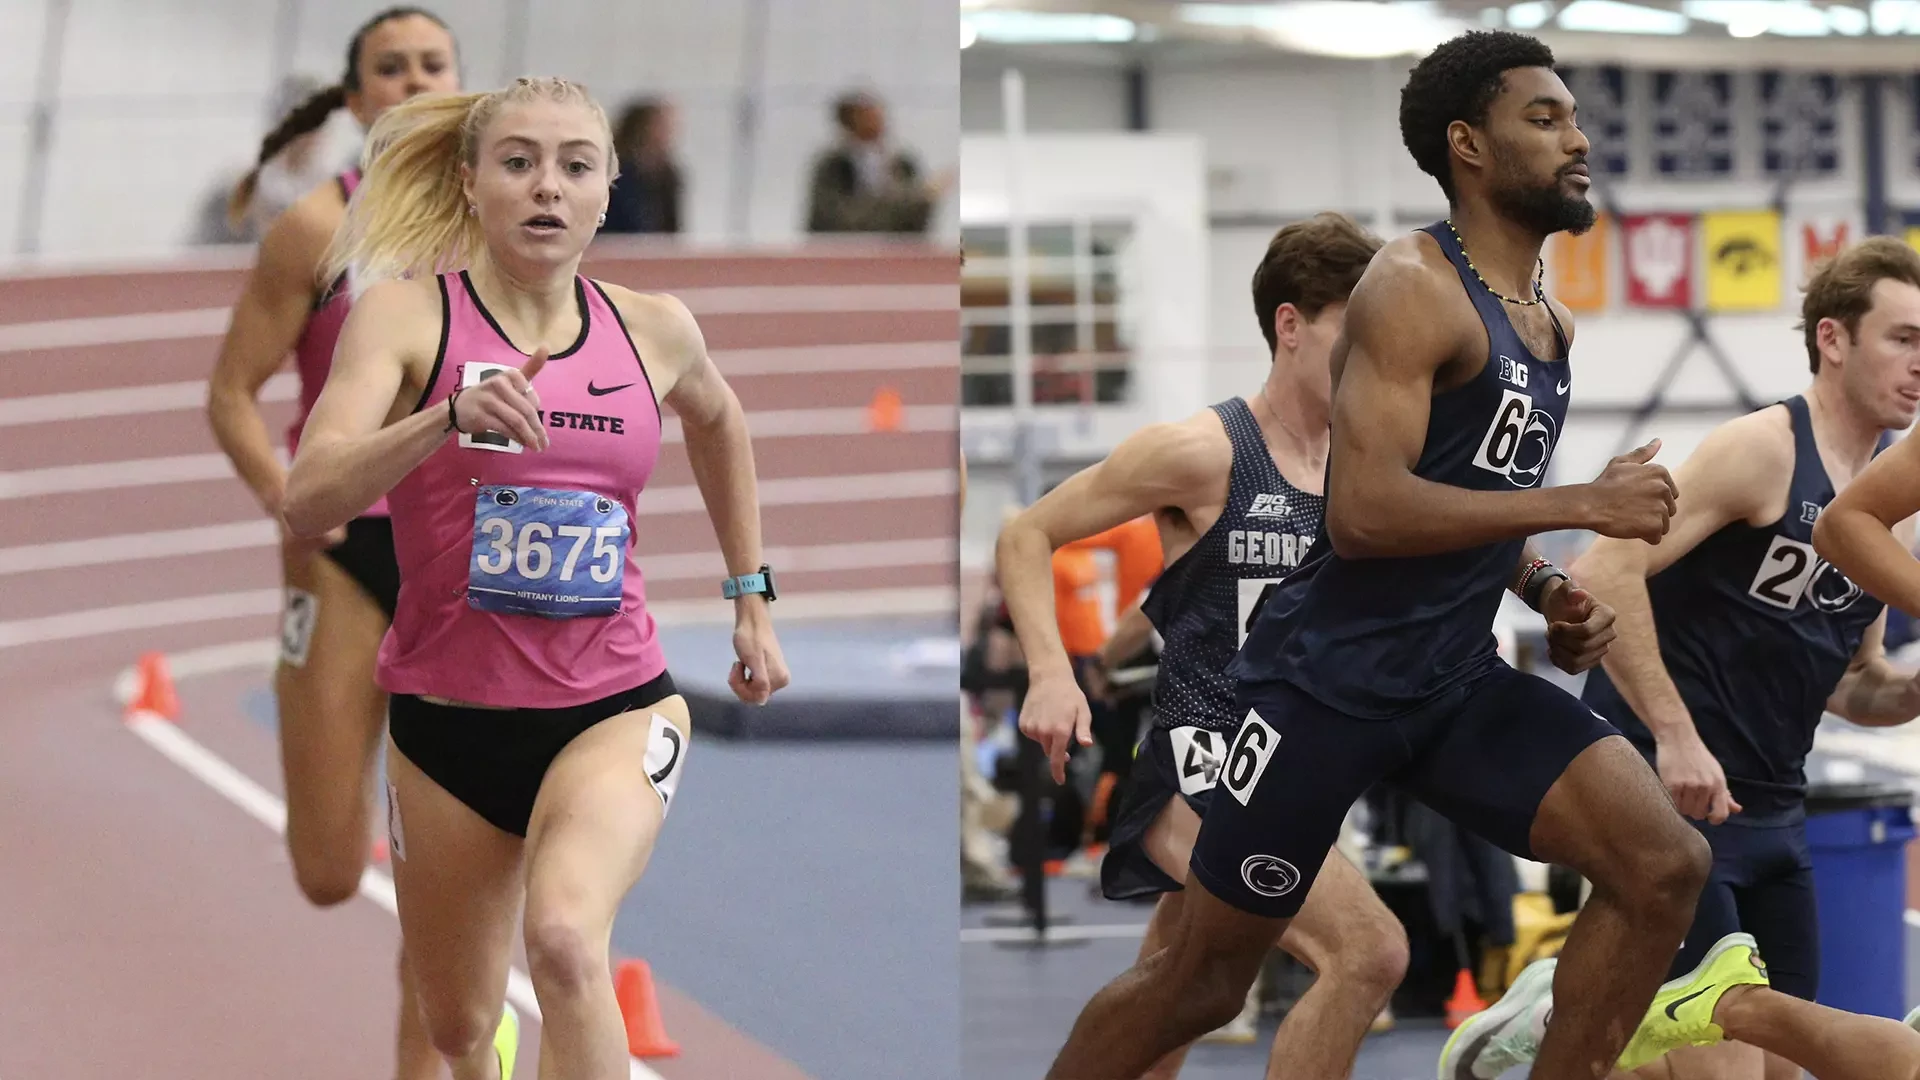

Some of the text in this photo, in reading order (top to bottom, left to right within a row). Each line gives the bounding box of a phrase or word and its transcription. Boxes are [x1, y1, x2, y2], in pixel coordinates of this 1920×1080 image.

[549, 410, 625, 436] STATE
[1486, 398, 1525, 469] 6
[532, 495, 585, 508] PENN STATE
[1249, 503, 1293, 517] EAST
[1254, 493, 1286, 505] BIG
[477, 517, 622, 584] 3675
[1755, 545, 1807, 605] 2
[516, 590, 580, 603] NITTANY LIONS
[1183, 729, 1221, 784] 4
[1228, 721, 1268, 792] 6
